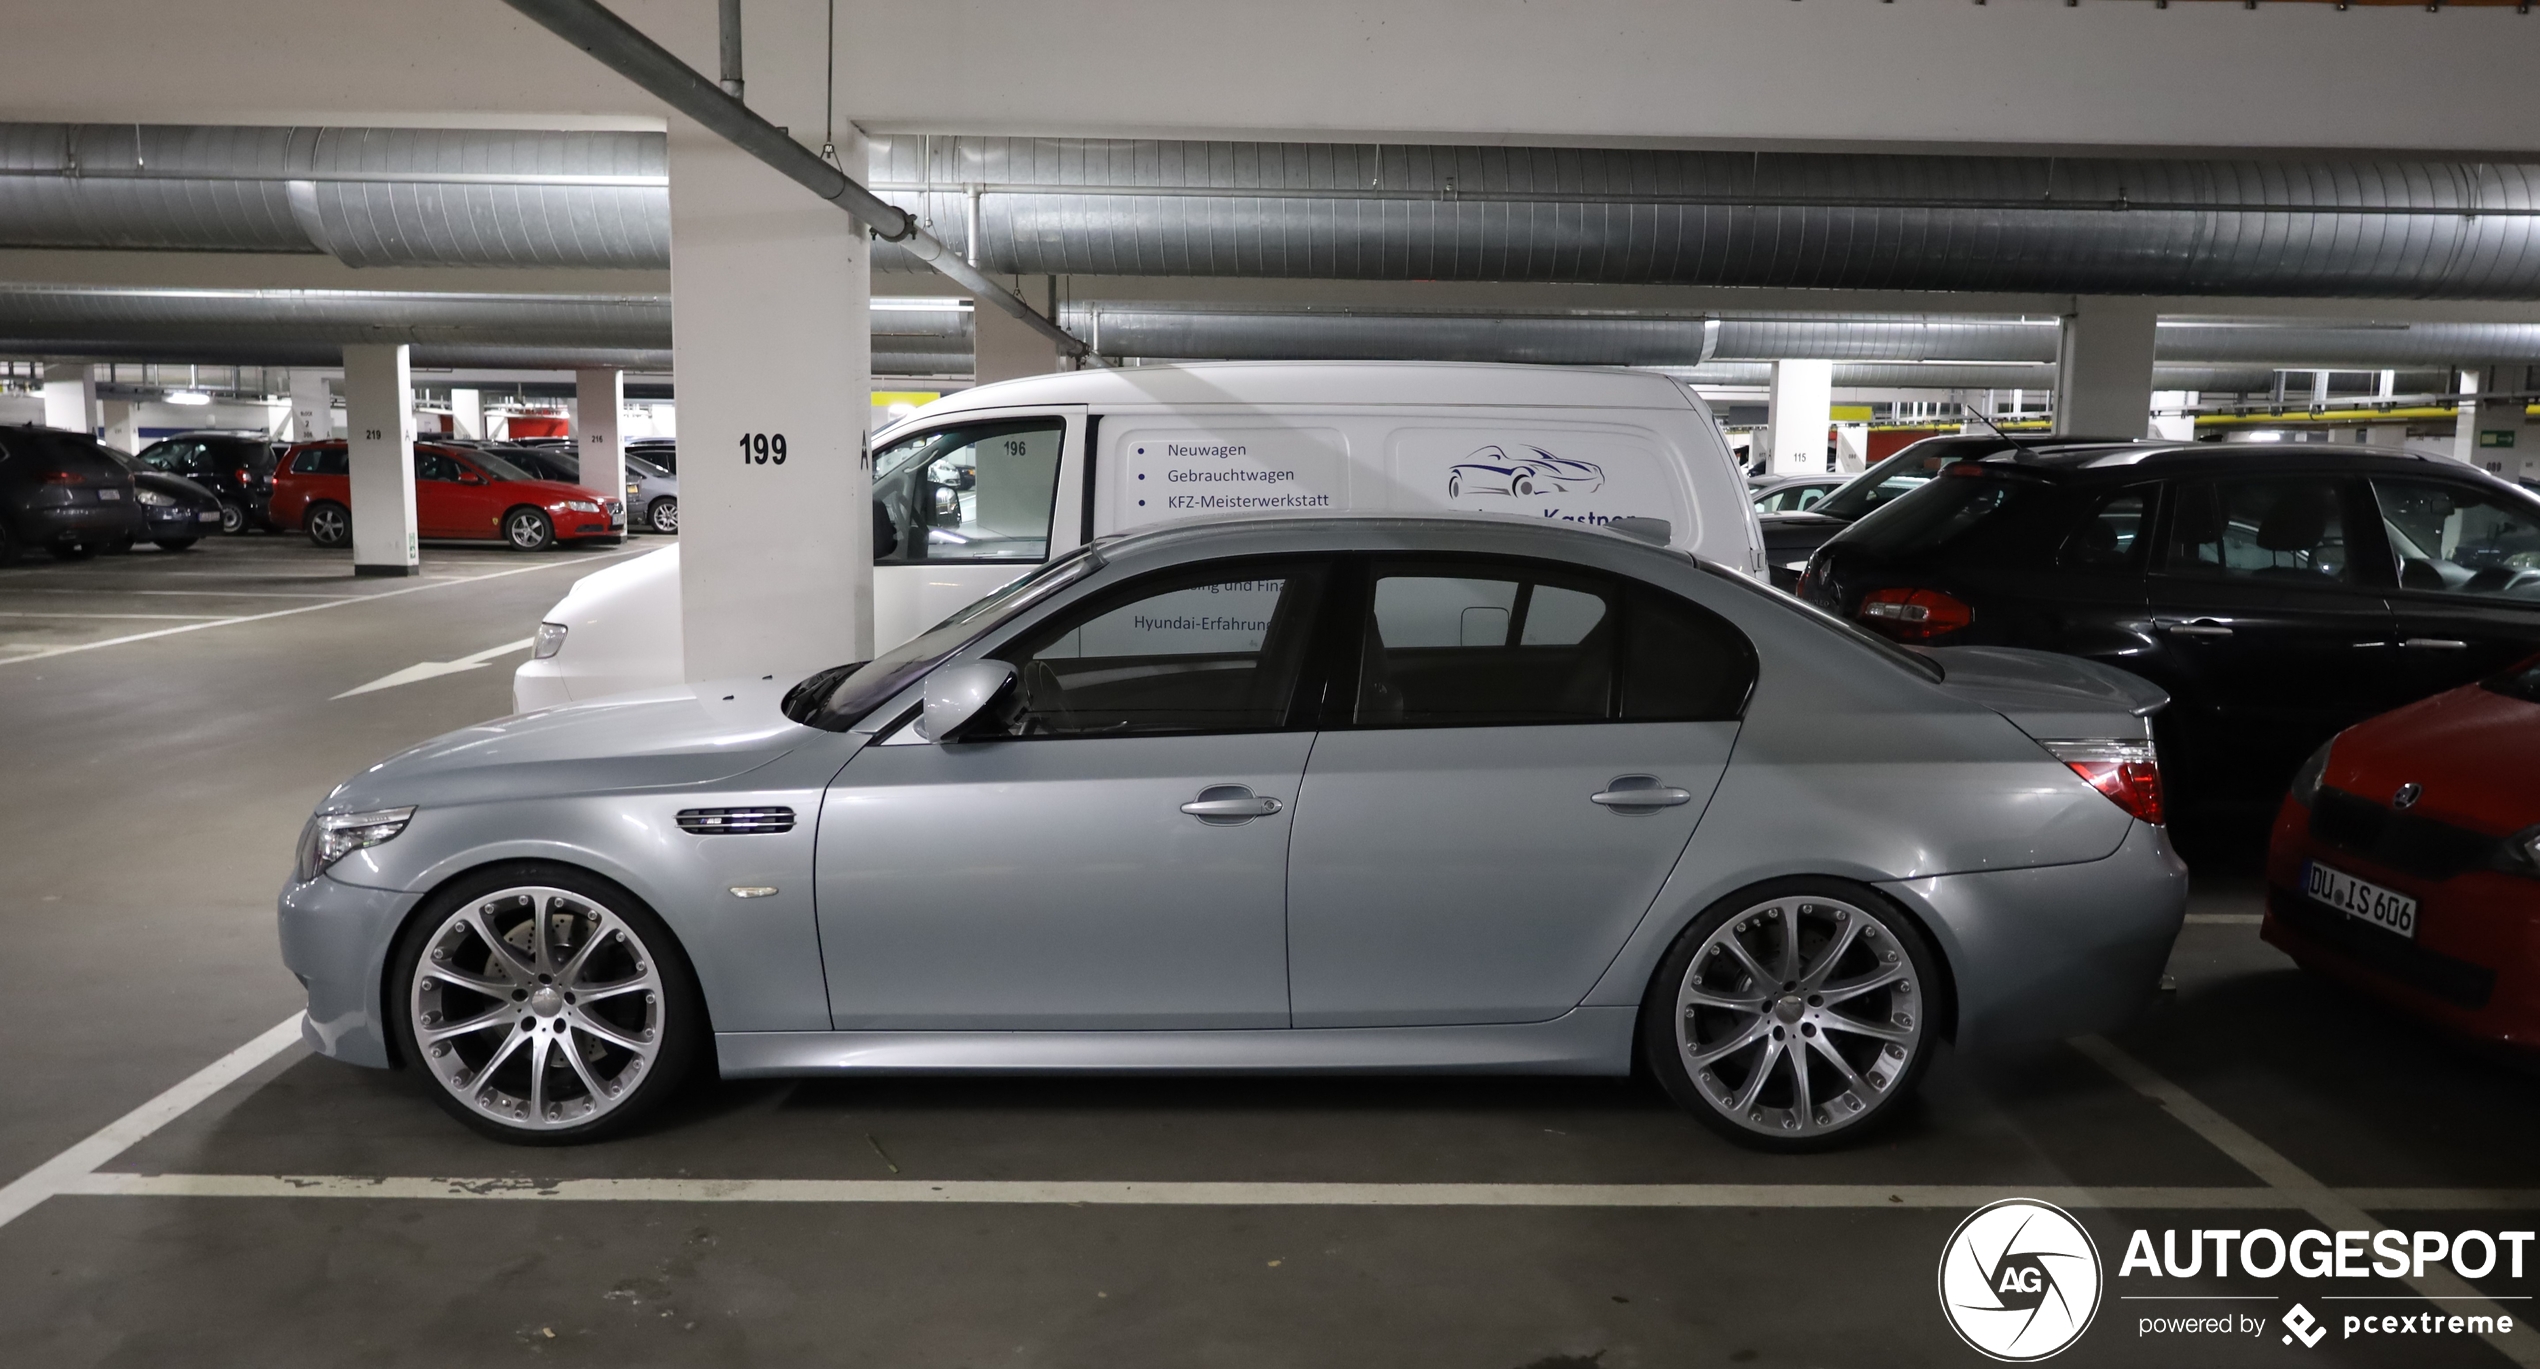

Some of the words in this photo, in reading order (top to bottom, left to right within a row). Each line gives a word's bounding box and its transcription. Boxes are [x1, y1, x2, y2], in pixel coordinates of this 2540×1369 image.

[366, 429, 381, 440] 219
[404, 430, 411, 441] A
[591, 435, 603, 443] 216
[739, 433, 787, 465] 199
[1004, 441, 1026, 456] 196
[1168, 444, 1246, 458] Neuwagen
[1794, 453, 1807, 462] 115
[1168, 469, 1294, 484] Gebrauchtwagen
[1168, 493, 1329, 508] KFZ-Meisterwerkstatt
[1224, 581, 1251, 591] und
[2309, 865, 2335, 900] DU
[2345, 881, 2370, 915] IS
[2374, 892, 2412, 931] 606
